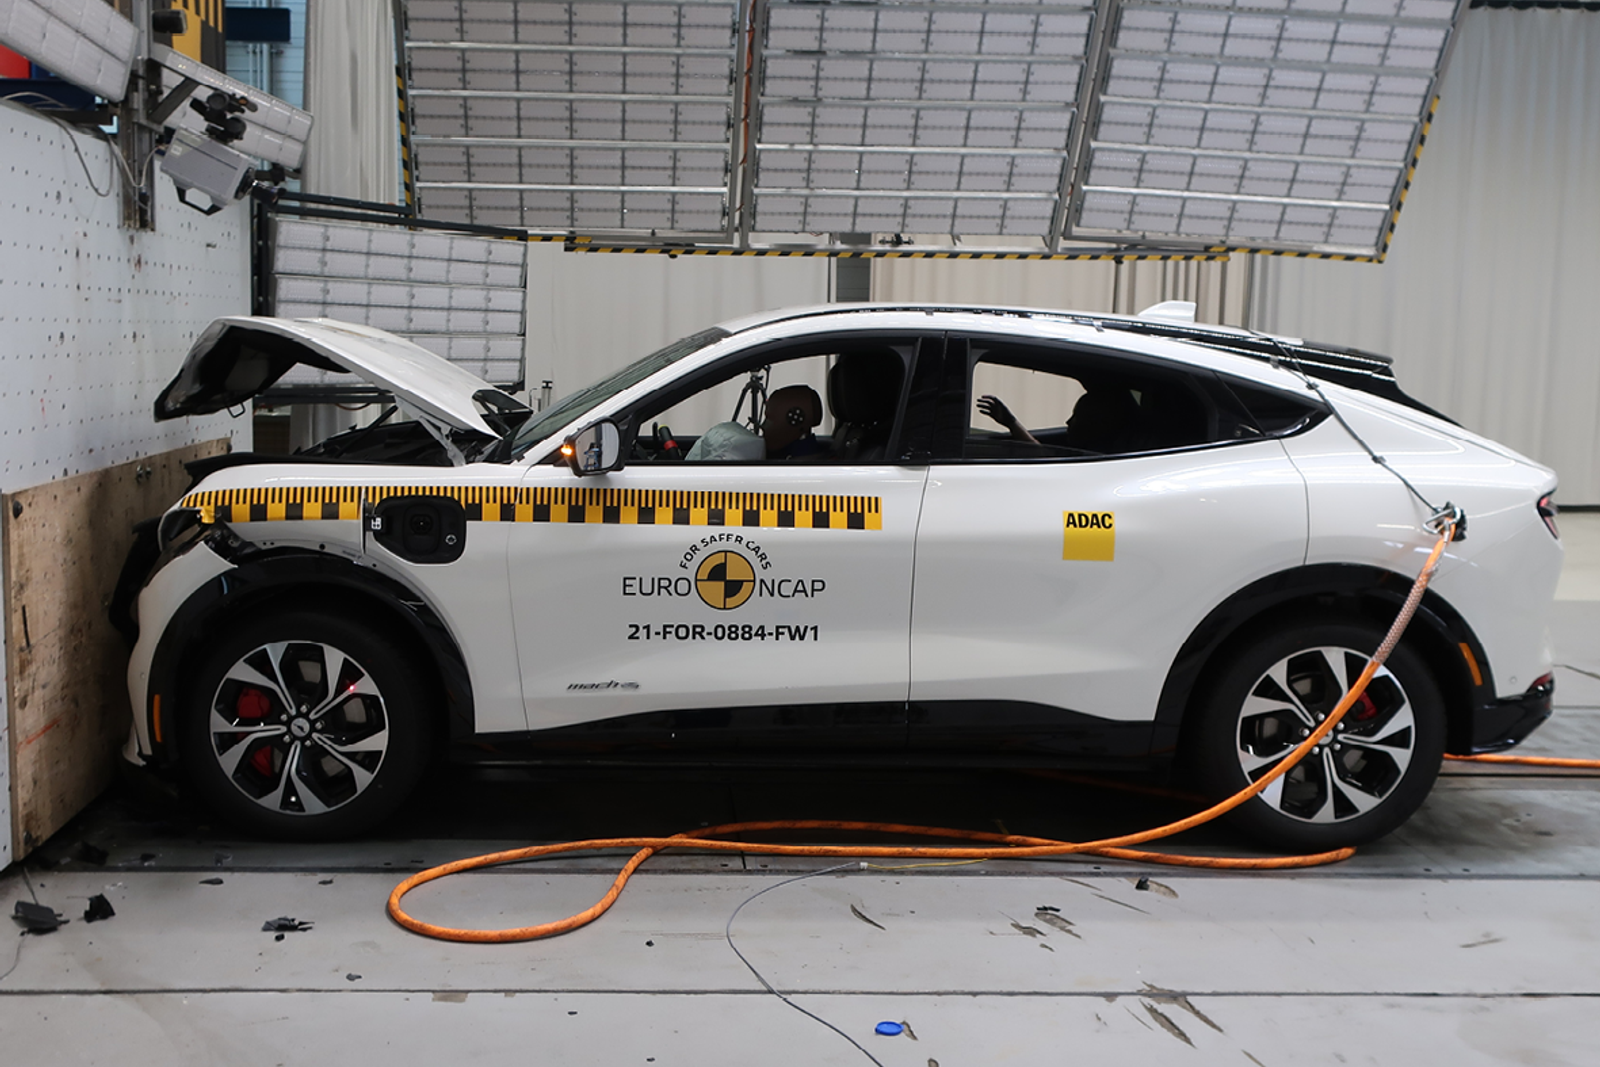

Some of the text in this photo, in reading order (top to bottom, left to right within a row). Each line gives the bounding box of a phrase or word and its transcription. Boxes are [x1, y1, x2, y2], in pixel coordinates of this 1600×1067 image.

[1066, 512, 1113, 529] ADAC
[679, 544, 701, 570] FOR
[745, 541, 772, 570] CARS
[622, 577, 826, 598] EURO NCAP
[627, 624, 819, 641] 21-FOR-0884-FW1
